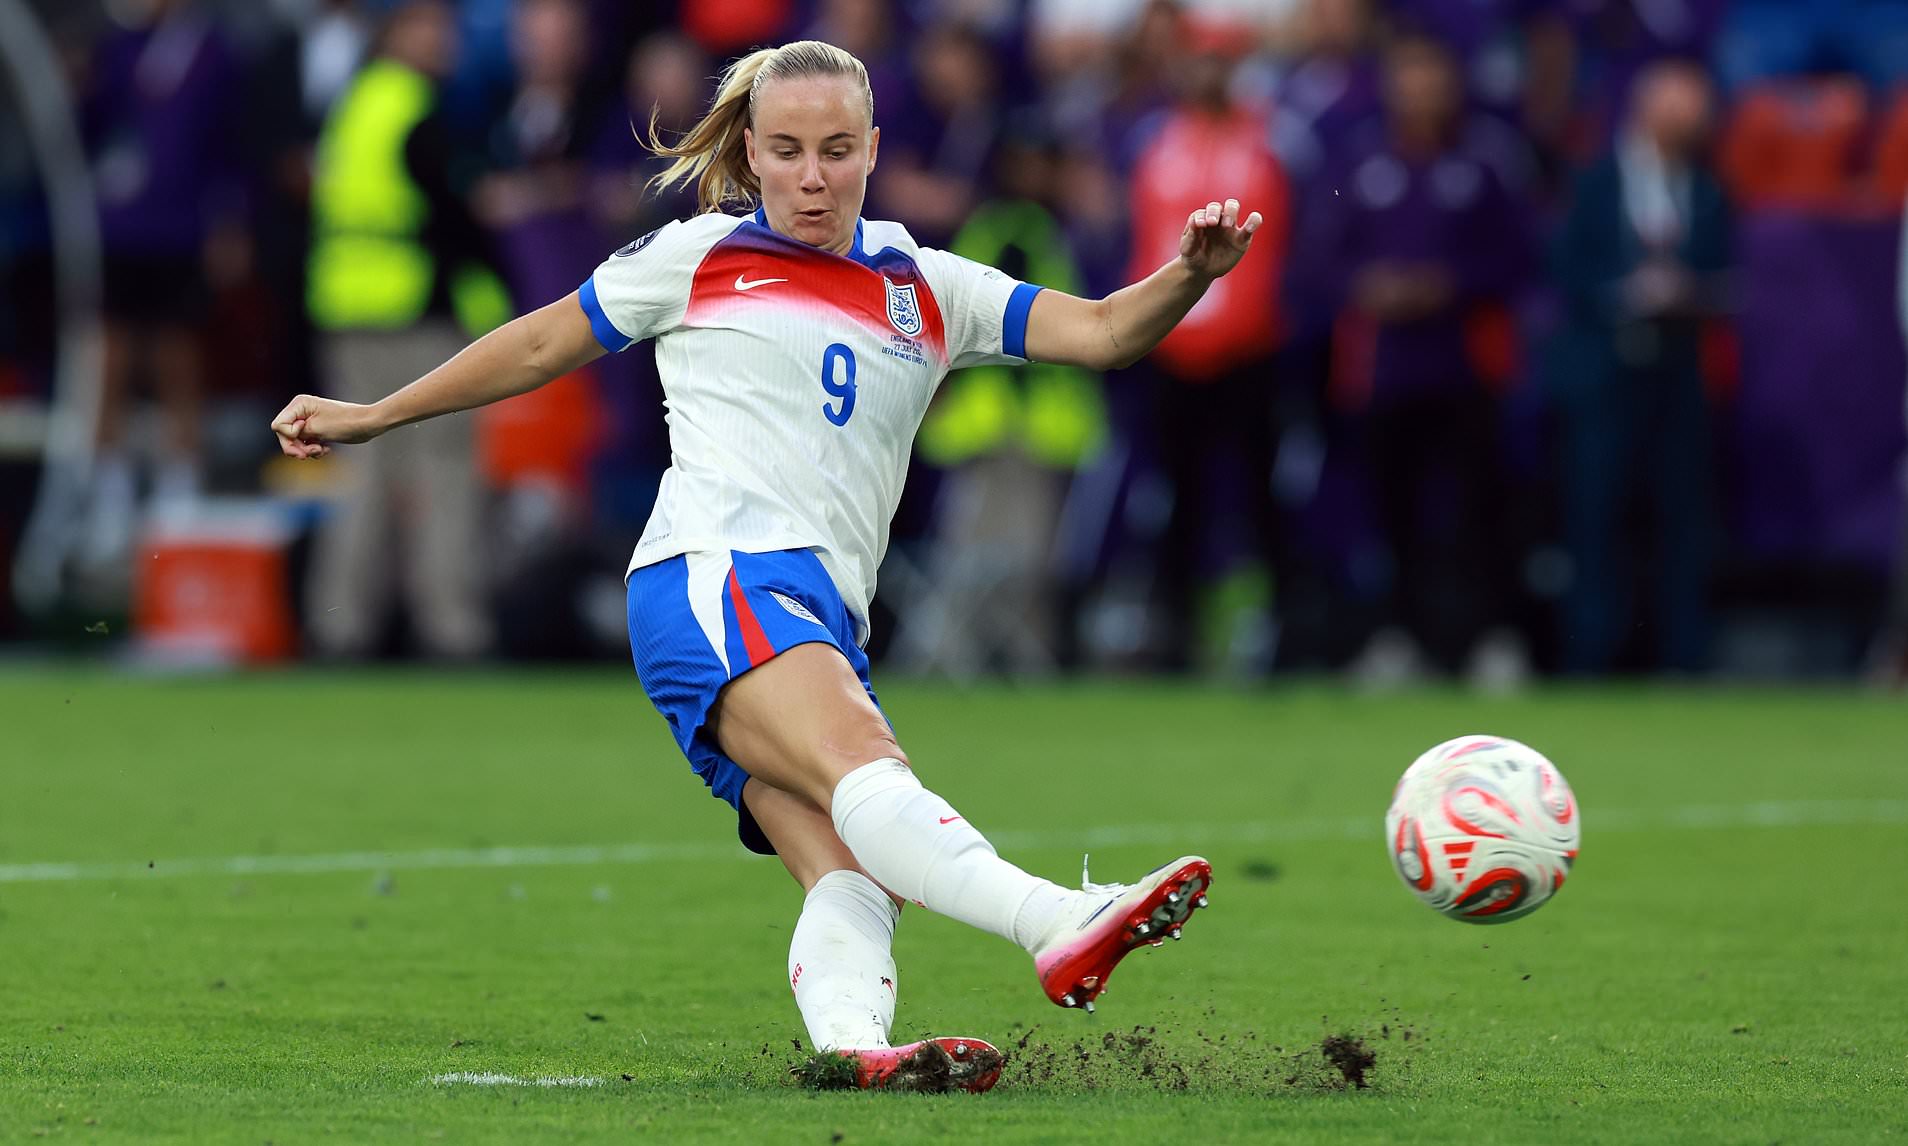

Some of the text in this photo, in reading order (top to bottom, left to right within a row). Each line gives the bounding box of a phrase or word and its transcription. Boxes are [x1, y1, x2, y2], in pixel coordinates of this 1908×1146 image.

[890, 335, 912, 344] ENGLAND
[882, 346, 894, 355] UEFA
[821, 342, 857, 427] 9
